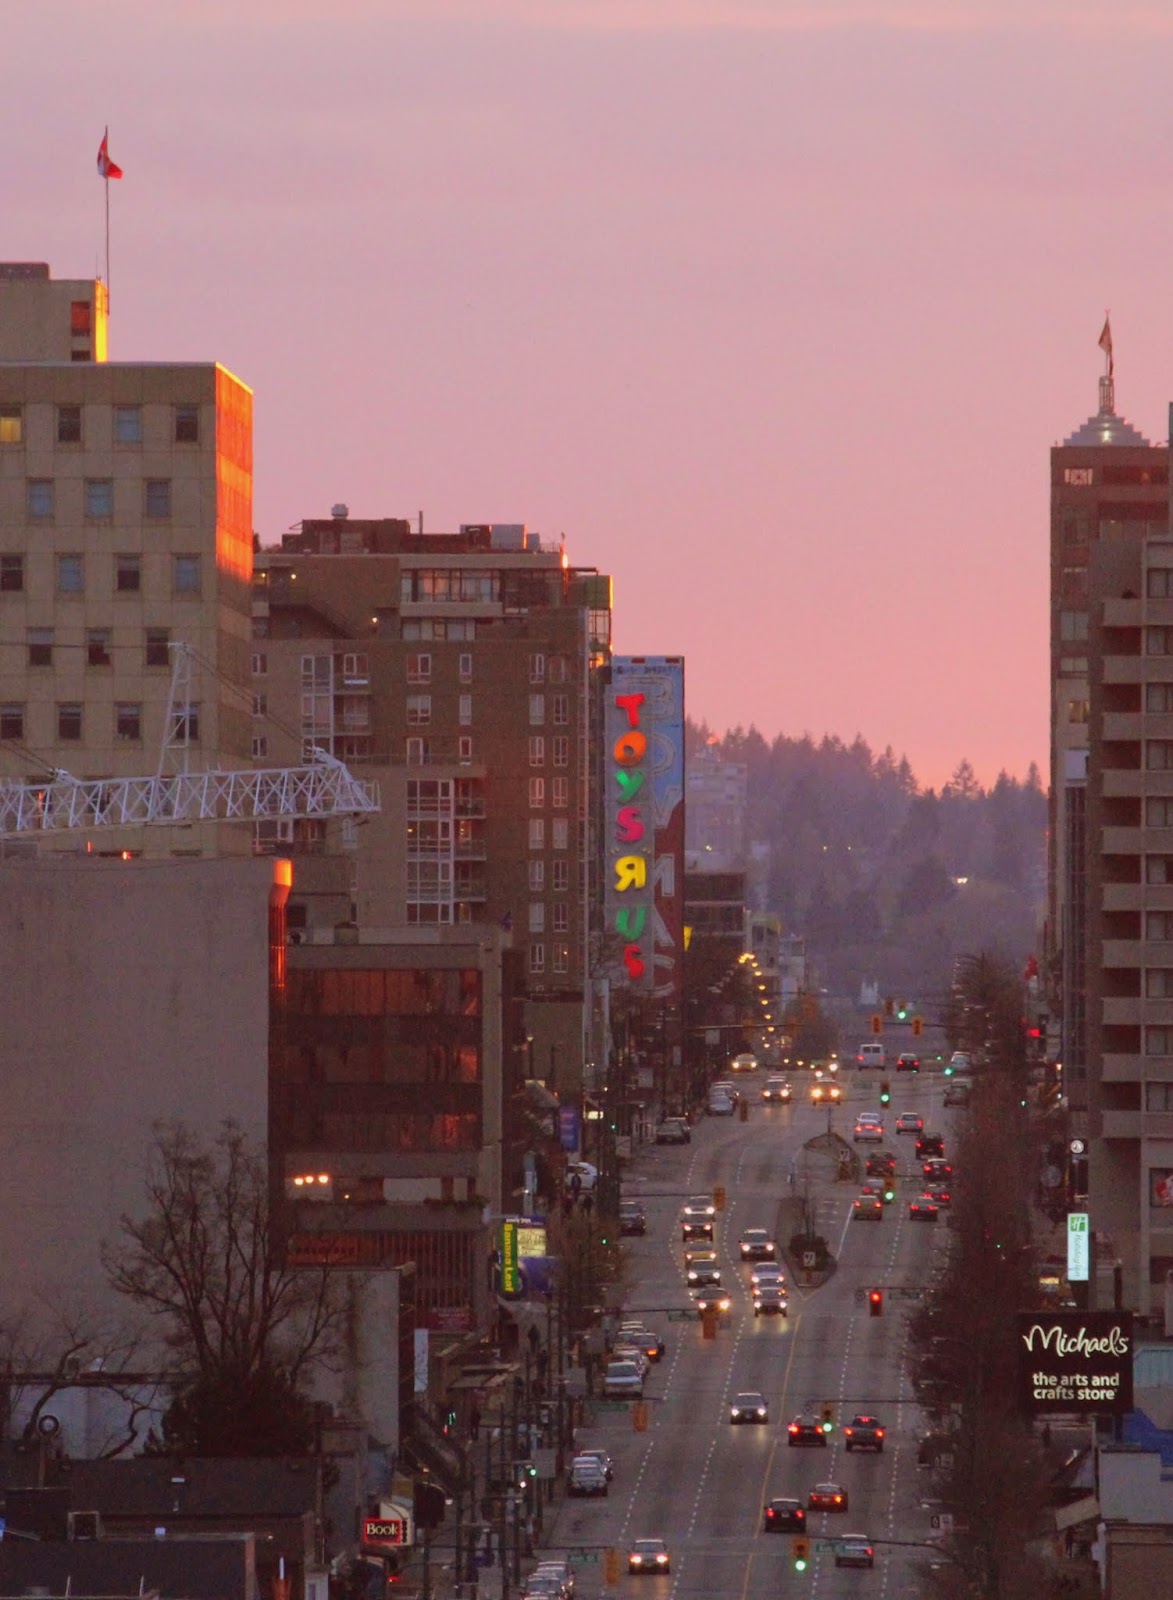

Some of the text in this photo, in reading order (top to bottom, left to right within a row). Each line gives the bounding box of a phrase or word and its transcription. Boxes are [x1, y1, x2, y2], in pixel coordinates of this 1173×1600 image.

[614, 693, 646, 842] TOYS
[615, 906, 645, 978] US
[504, 1224, 513, 1265] Banana
[1022, 1325, 1129, 1357] Michaels
[1033, 1372, 1119, 1386] the arts and
[1034, 1386, 1115, 1400] crafts store
[366, 1522, 399, 1535] Book
